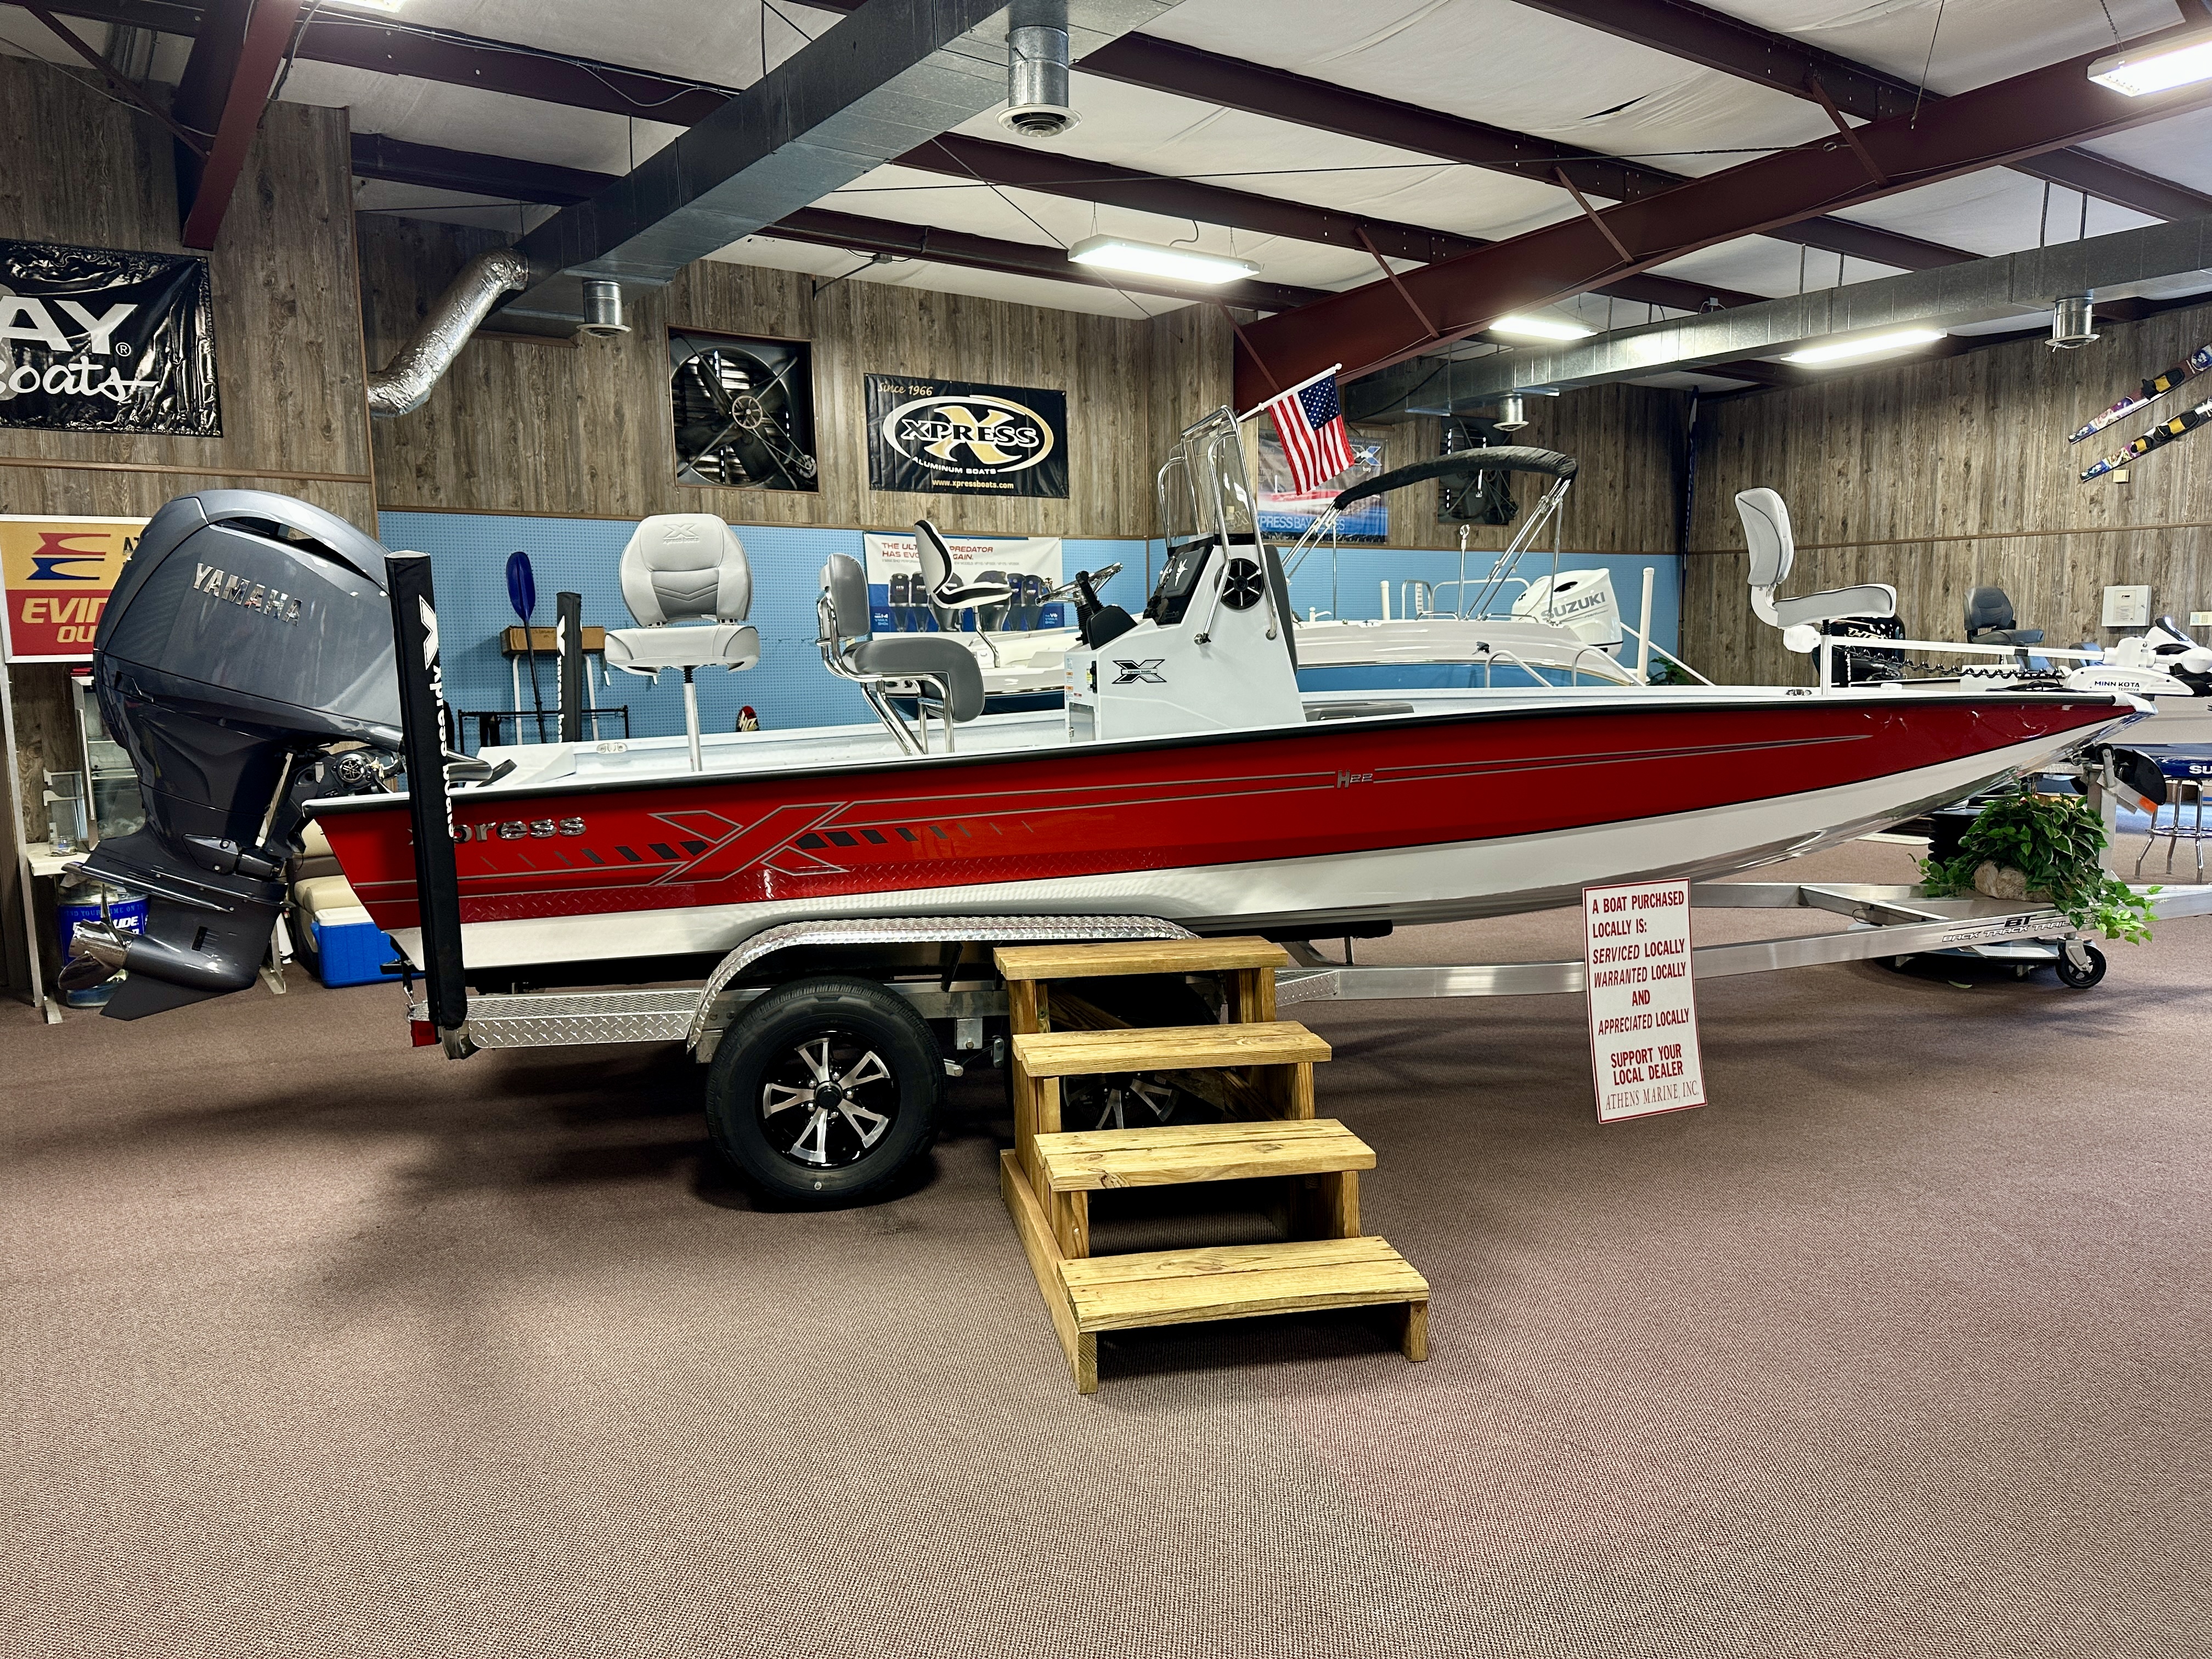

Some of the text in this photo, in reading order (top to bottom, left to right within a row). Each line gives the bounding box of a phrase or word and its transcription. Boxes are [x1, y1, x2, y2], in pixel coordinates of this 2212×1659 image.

[878, 381, 933, 396] Since 1966
[900, 419, 1040, 448] XPRESS
[912, 456, 963, 474] ALUMINUM
[932, 479, 1014, 490] www.xpressboats.com
[193, 563, 302, 627] YAMAHA
[1541, 591, 1606, 621] SUZUKI
[1592, 890, 1684, 915] A BOAT PURCHASED
[1593, 918, 1647, 938] LOCALLY IS:
[1983, 924, 2031, 938] TRACK
[2004, 914, 2038, 928] BT
[1593, 938, 1685, 964] SERVICED LOCALLY
[1594, 961, 1686, 988] WARRANTED LOCALLY
[1632, 989, 1651, 1007] AND
[1598, 1008, 1689, 1036] APPRECIATED LOCALLY
[1611, 1043, 1682, 1069] SUPPORT YOUR
[1613, 1060, 1684, 1086] LOCAL DEALER
[1605, 1080, 1699, 1111] ATHENS MARINE, INC.
